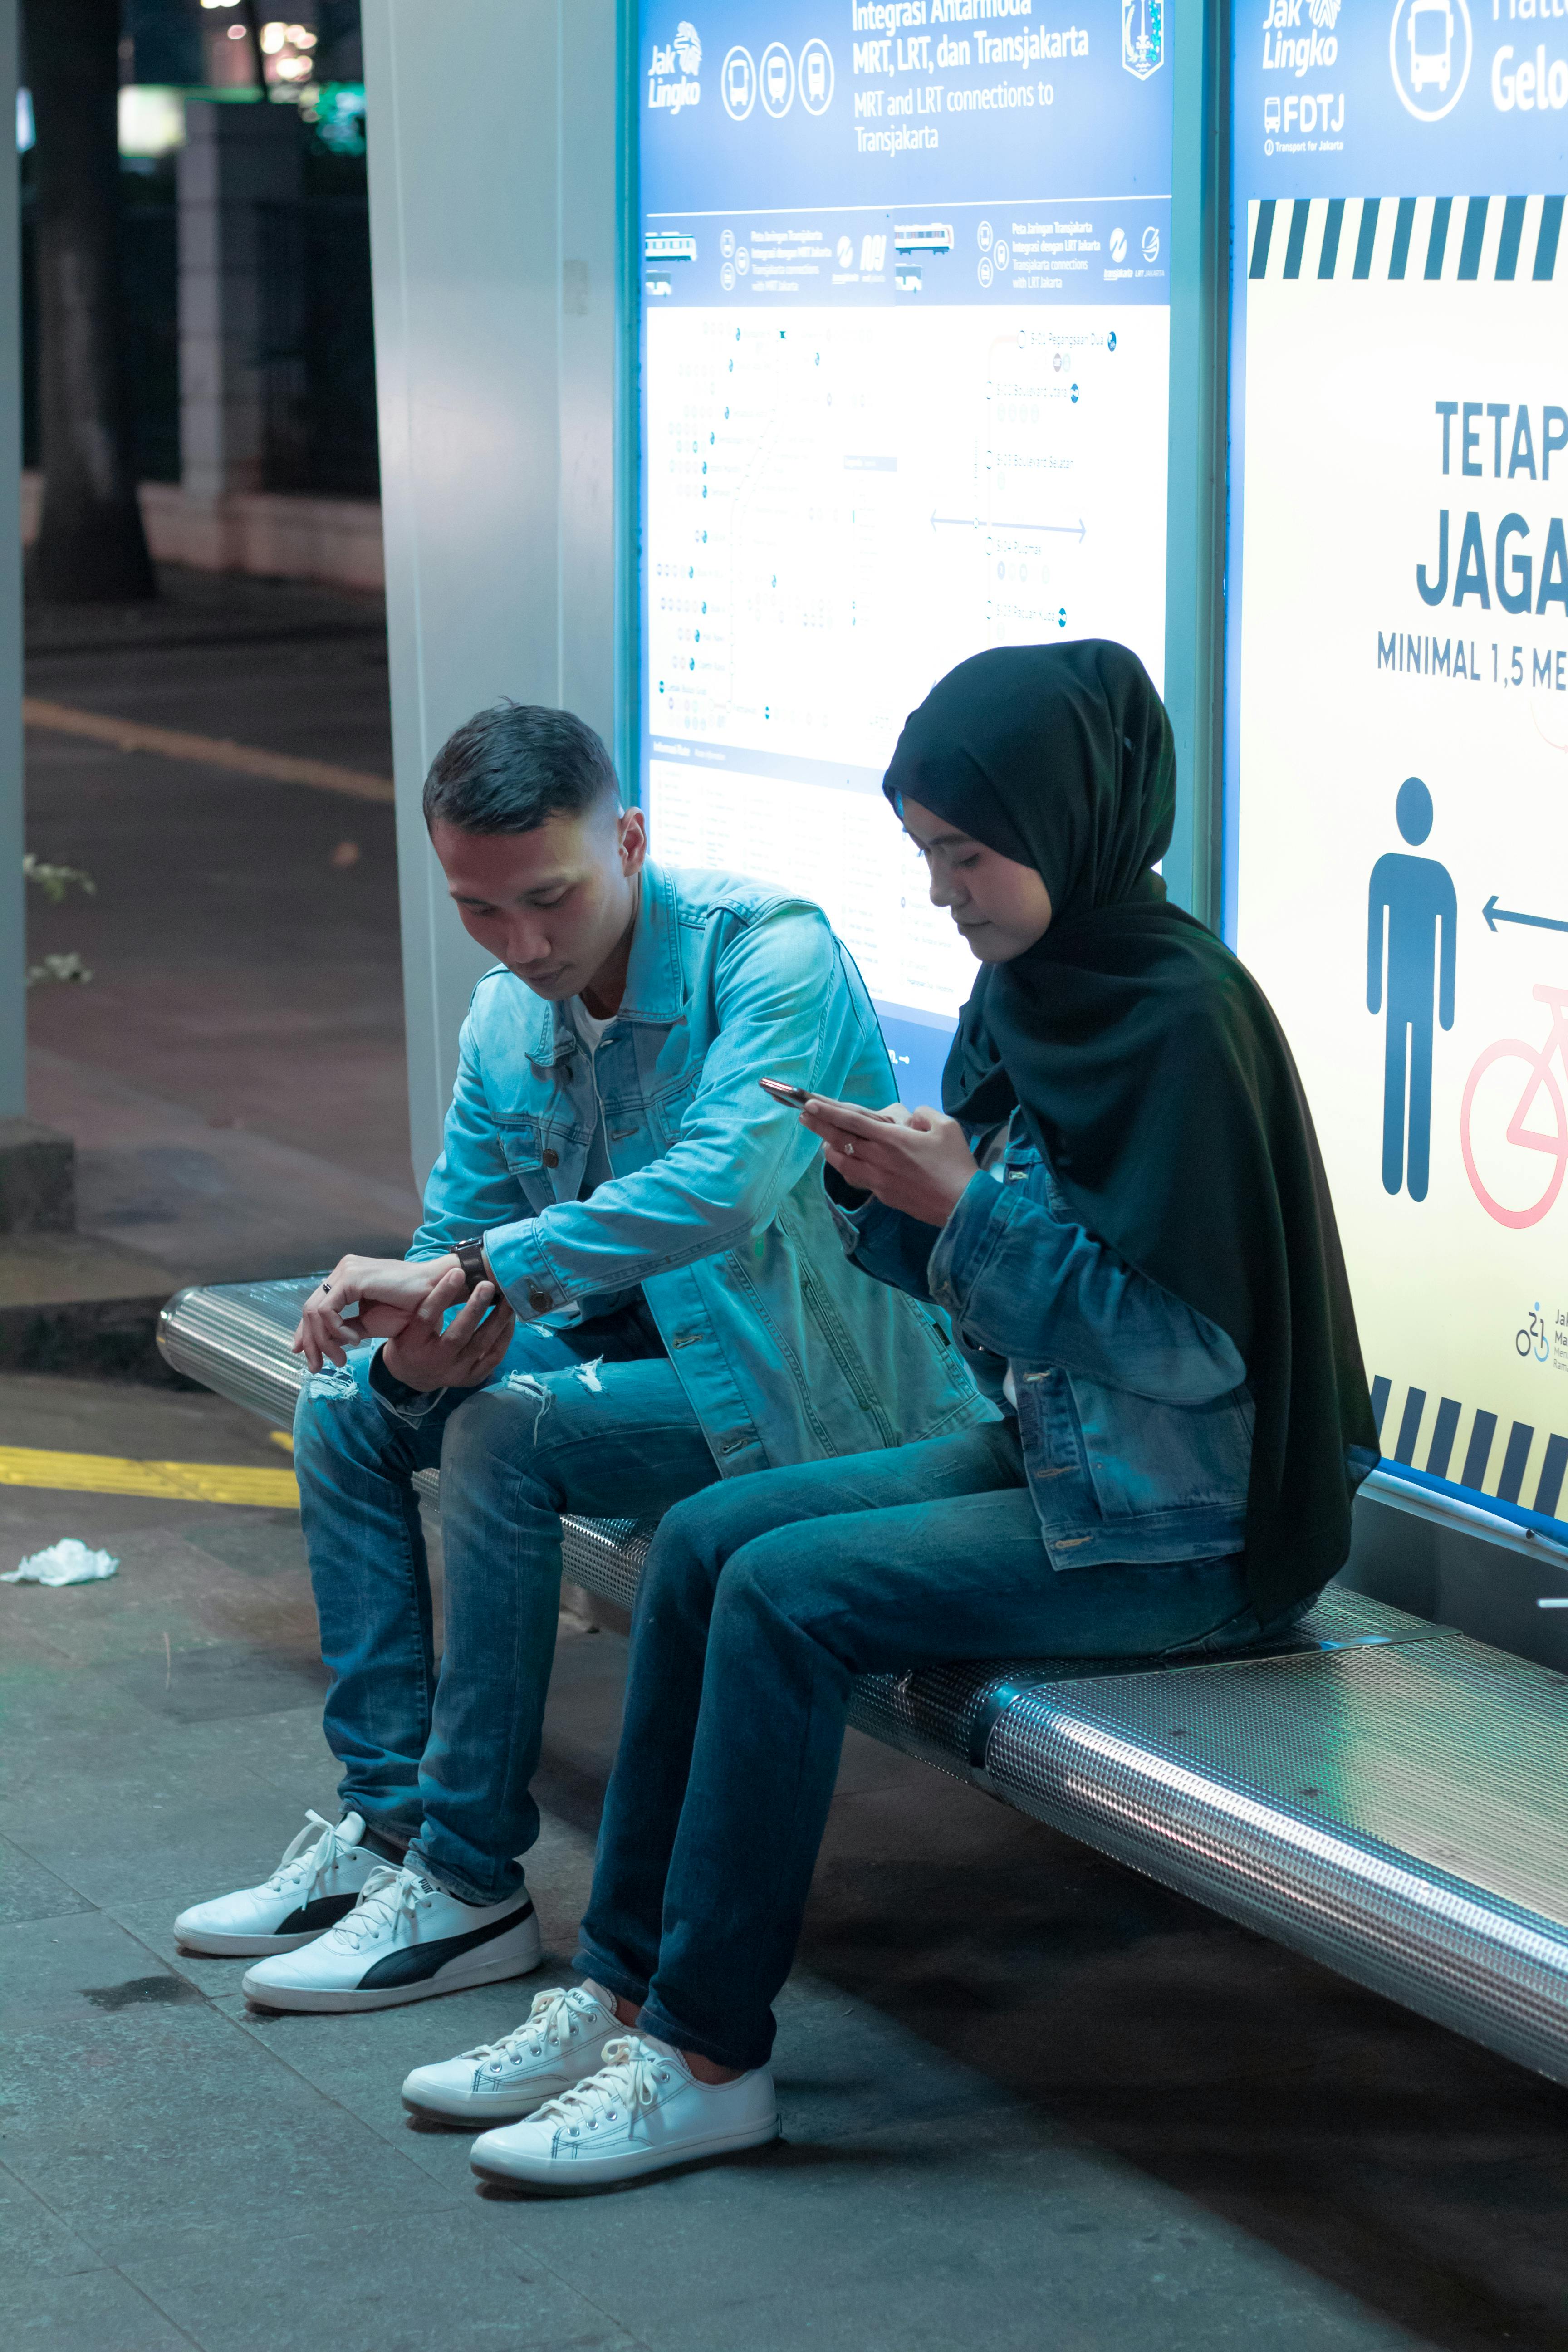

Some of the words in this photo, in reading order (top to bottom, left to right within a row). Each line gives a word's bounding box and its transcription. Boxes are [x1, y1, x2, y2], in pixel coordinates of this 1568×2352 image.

[852, 0, 926, 37] Integrasi
[1263, 0, 1301, 29] Jak
[648, 44, 676, 76] Jak
[853, 40, 895, 77] MRT,
[897, 36, 934, 74] LRT,
[937, 34, 970, 68] dan
[974, 25, 1089, 69] Transjakarta
[1263, 29, 1338, 78] Lingko
[648, 75, 701, 114] Lingko
[1492, 44, 1568, 112] Gelo
[854, 91, 885, 118] MRT
[887, 88, 913, 115] and
[917, 86, 944, 114] LRT
[947, 81, 1034, 112] connections
[1039, 81, 1054, 106] to
[1284, 93, 1345, 133] FDTJ
[854, 124, 939, 157] Transjakarta
[1275, 141, 1306, 154] Transport
[1307, 141, 1318, 151] for
[1318, 140, 1344, 151] Jakarta
[1435, 401, 1568, 481] TETAP
[1416, 509, 1568, 618] JAGA
[1377, 631, 1481, 681] MINIMAL
[1491, 643, 1523, 689] 1,5
